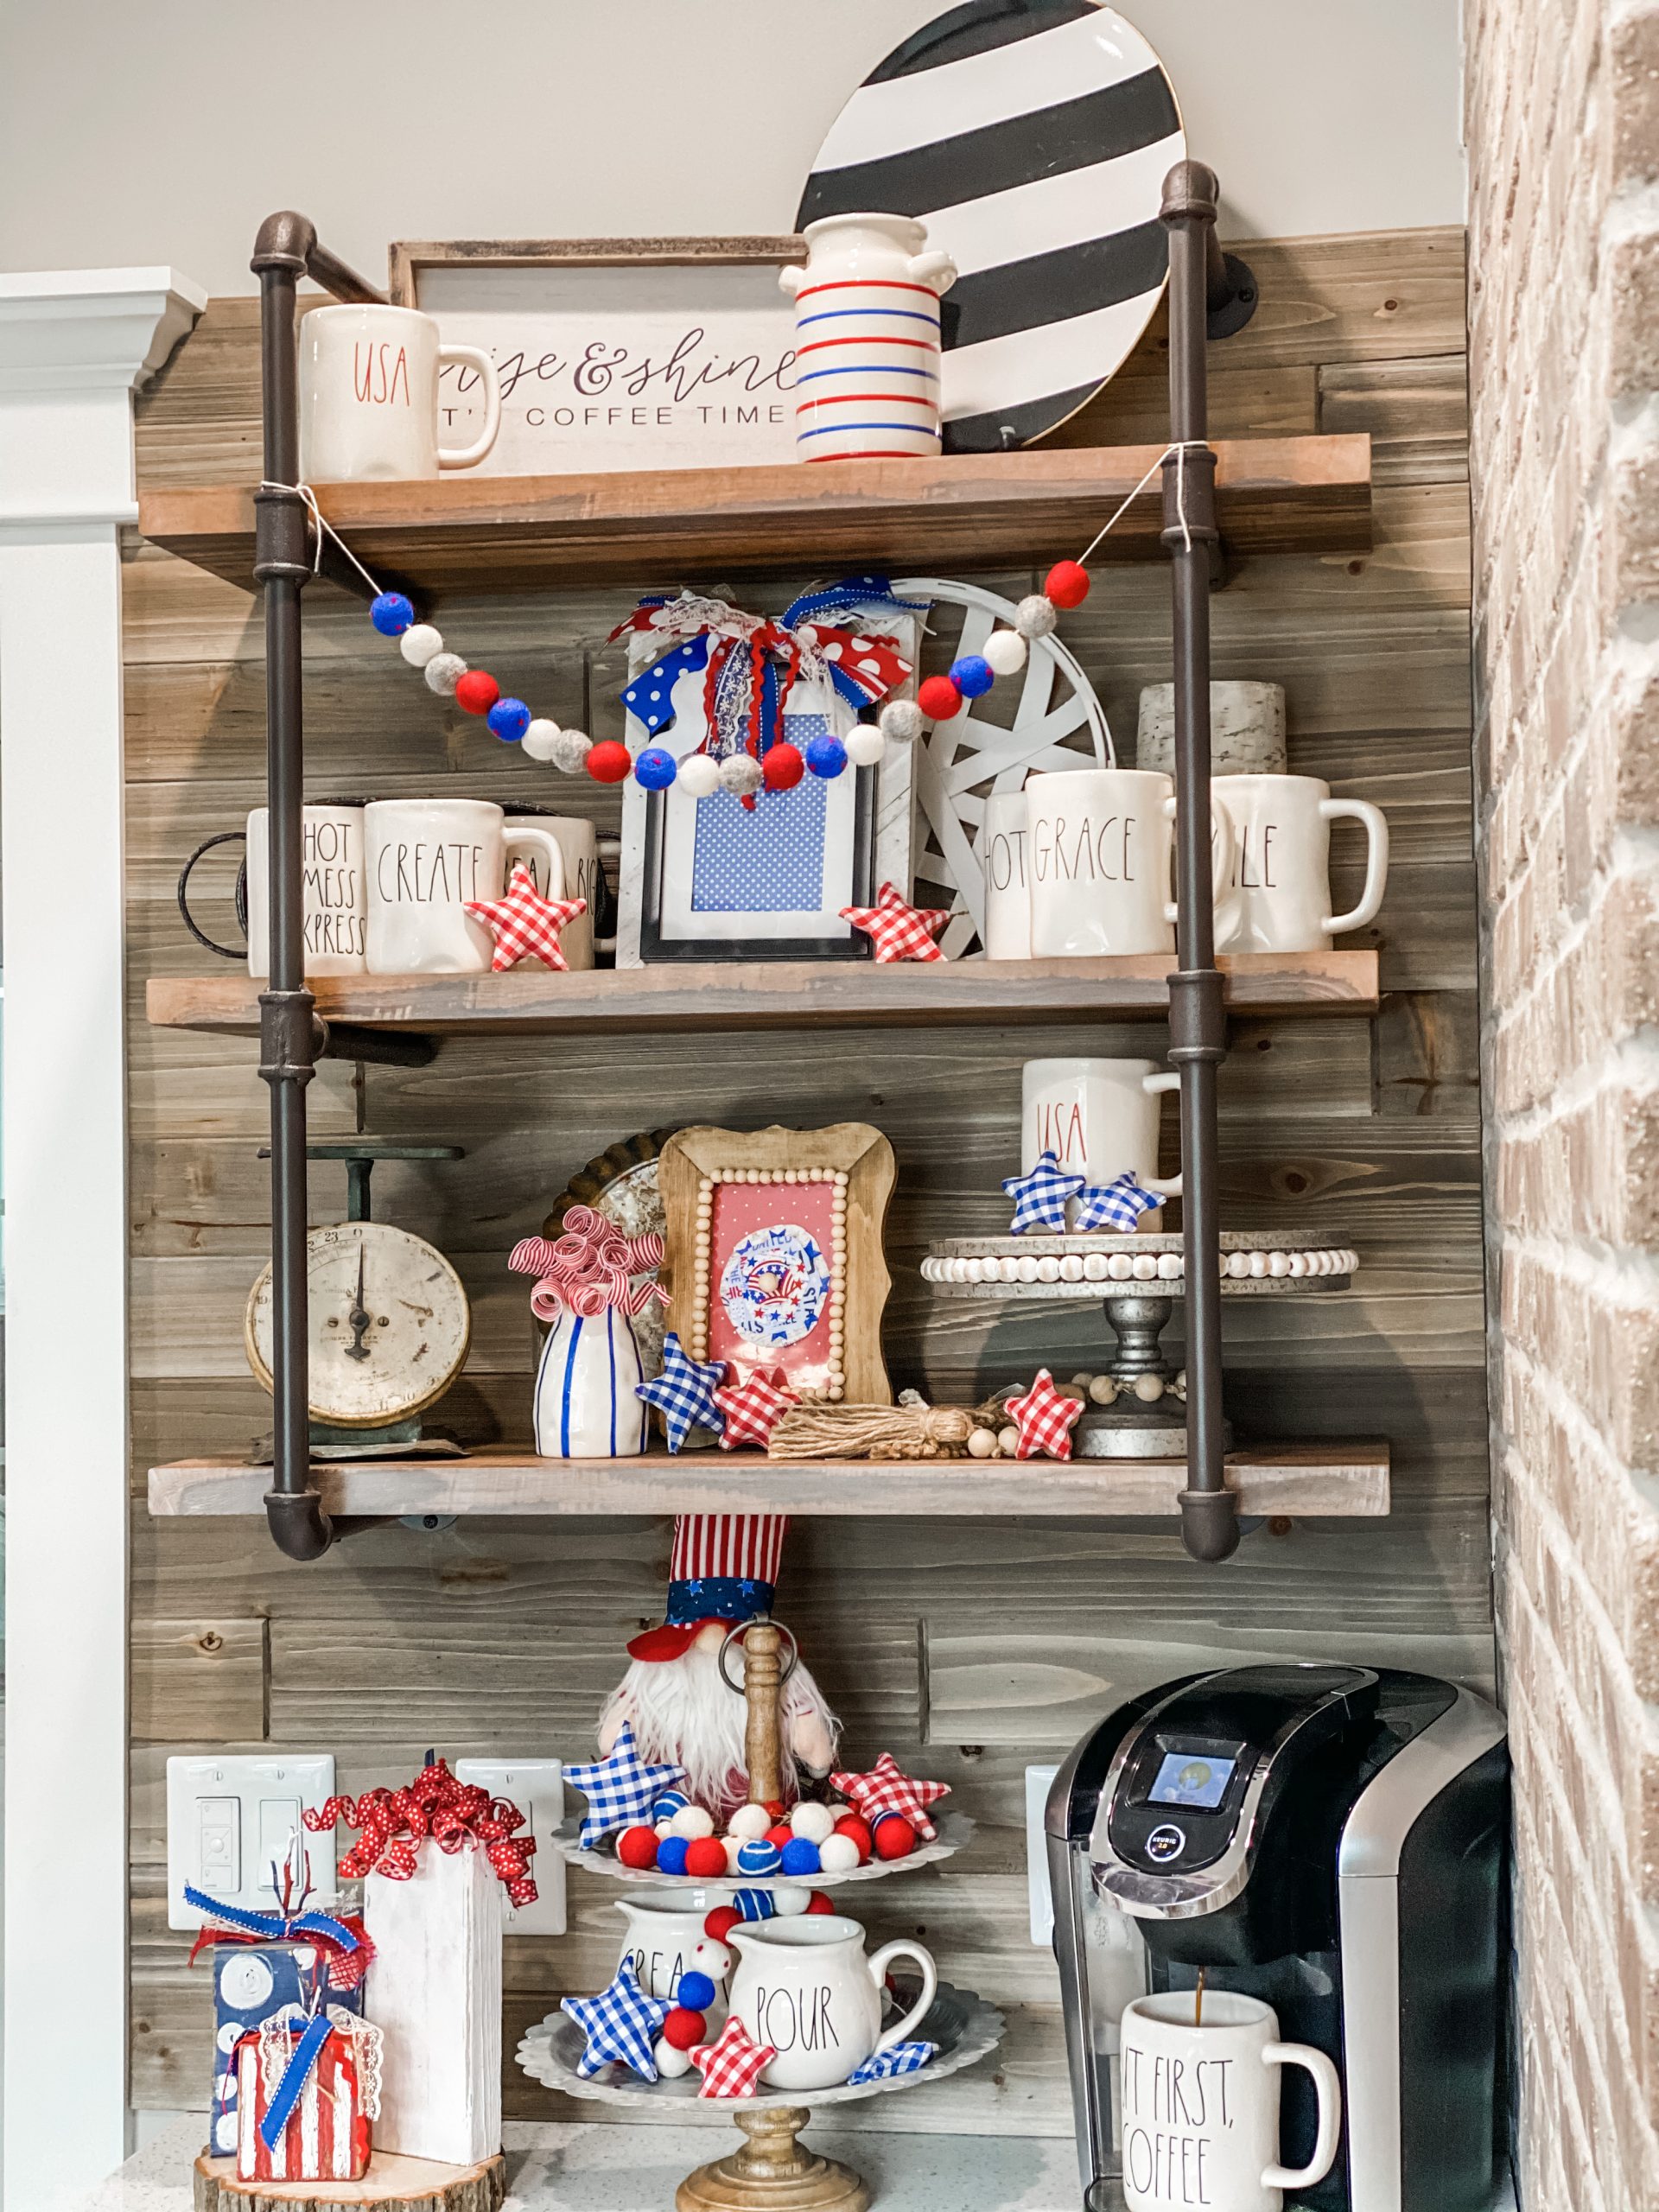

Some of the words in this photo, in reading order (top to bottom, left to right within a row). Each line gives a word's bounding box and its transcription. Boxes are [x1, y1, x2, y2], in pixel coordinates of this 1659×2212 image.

[353, 340, 410, 407] USA
[525, 407, 673, 427] COFFEE
[696, 404, 785, 424] TIME
[303, 823, 352, 862] HOT
[378, 842, 483, 903] CREATE
[1034, 817, 1136, 881] GRACE
[303, 868, 356, 909] MESS
[303, 914, 365, 956] XPRESS
[1037, 1103, 1086, 1163] USA
[324, 1231, 339, 1243] 23
[1152, 1836, 1177, 1845] KEURIG
[758, 1986, 839, 2052] POUR
[1154, 2056, 1234, 2129] FIRST,
[1123, 2122, 1211, 2205] COFFEE
